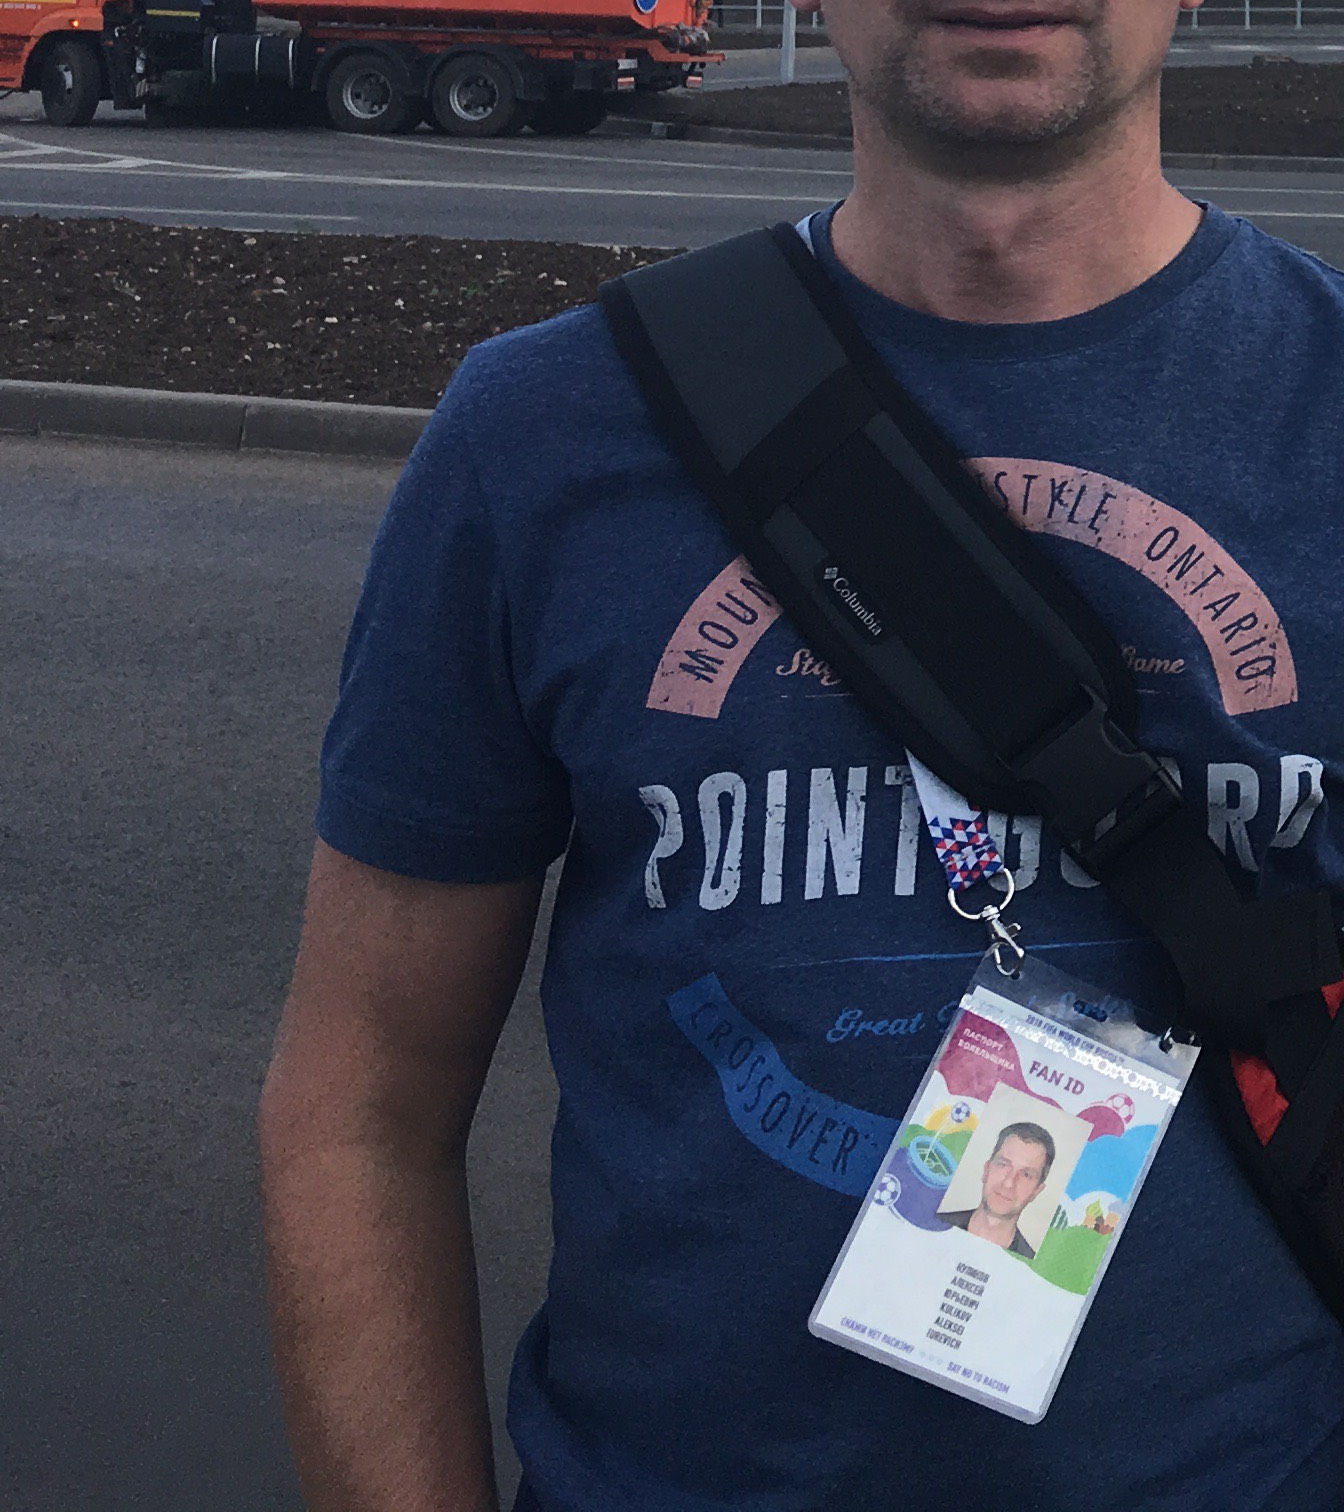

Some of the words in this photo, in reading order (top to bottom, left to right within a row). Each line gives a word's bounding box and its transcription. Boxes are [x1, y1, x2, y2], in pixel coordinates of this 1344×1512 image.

[978, 471, 1117, 535] STYLE
[1145, 526, 1277, 681] ONTARIO
[833, 577, 882, 637] Columbia
[638, 765, 919, 911] POINT
[826, 1007, 925, 1044] Great
[1043, 1023, 1057, 1034] FIFA
[1058, 1030, 1080, 1046] WORLD
[1081, 1041, 1093, 1051] CUP
[962, 1028, 1004, 1052] ПАСПОРТ
[689, 1002, 860, 1176] CROSSOVER
[1028, 1059, 1065, 1089] FAN
[1062, 1075, 1086, 1097] ID
[943, 1288, 980, 1310] ЮРЬЕВИЧ
[950, 1276, 985, 1297] АЛЕКСЕЙ
[933, 1316, 966, 1336] ALEKSEI
[939, 1302, 973, 1322] KULIKOV
[868, 1328, 881, 1340] НЕТ
[926, 1328, 962, 1350] IUREVICH
[948, 1362, 961, 1373] SAY
[962, 1368, 972, 1378] NO
[973, 1372, 982, 1382] TO
[983, 1376, 1010, 1394] RACISM
